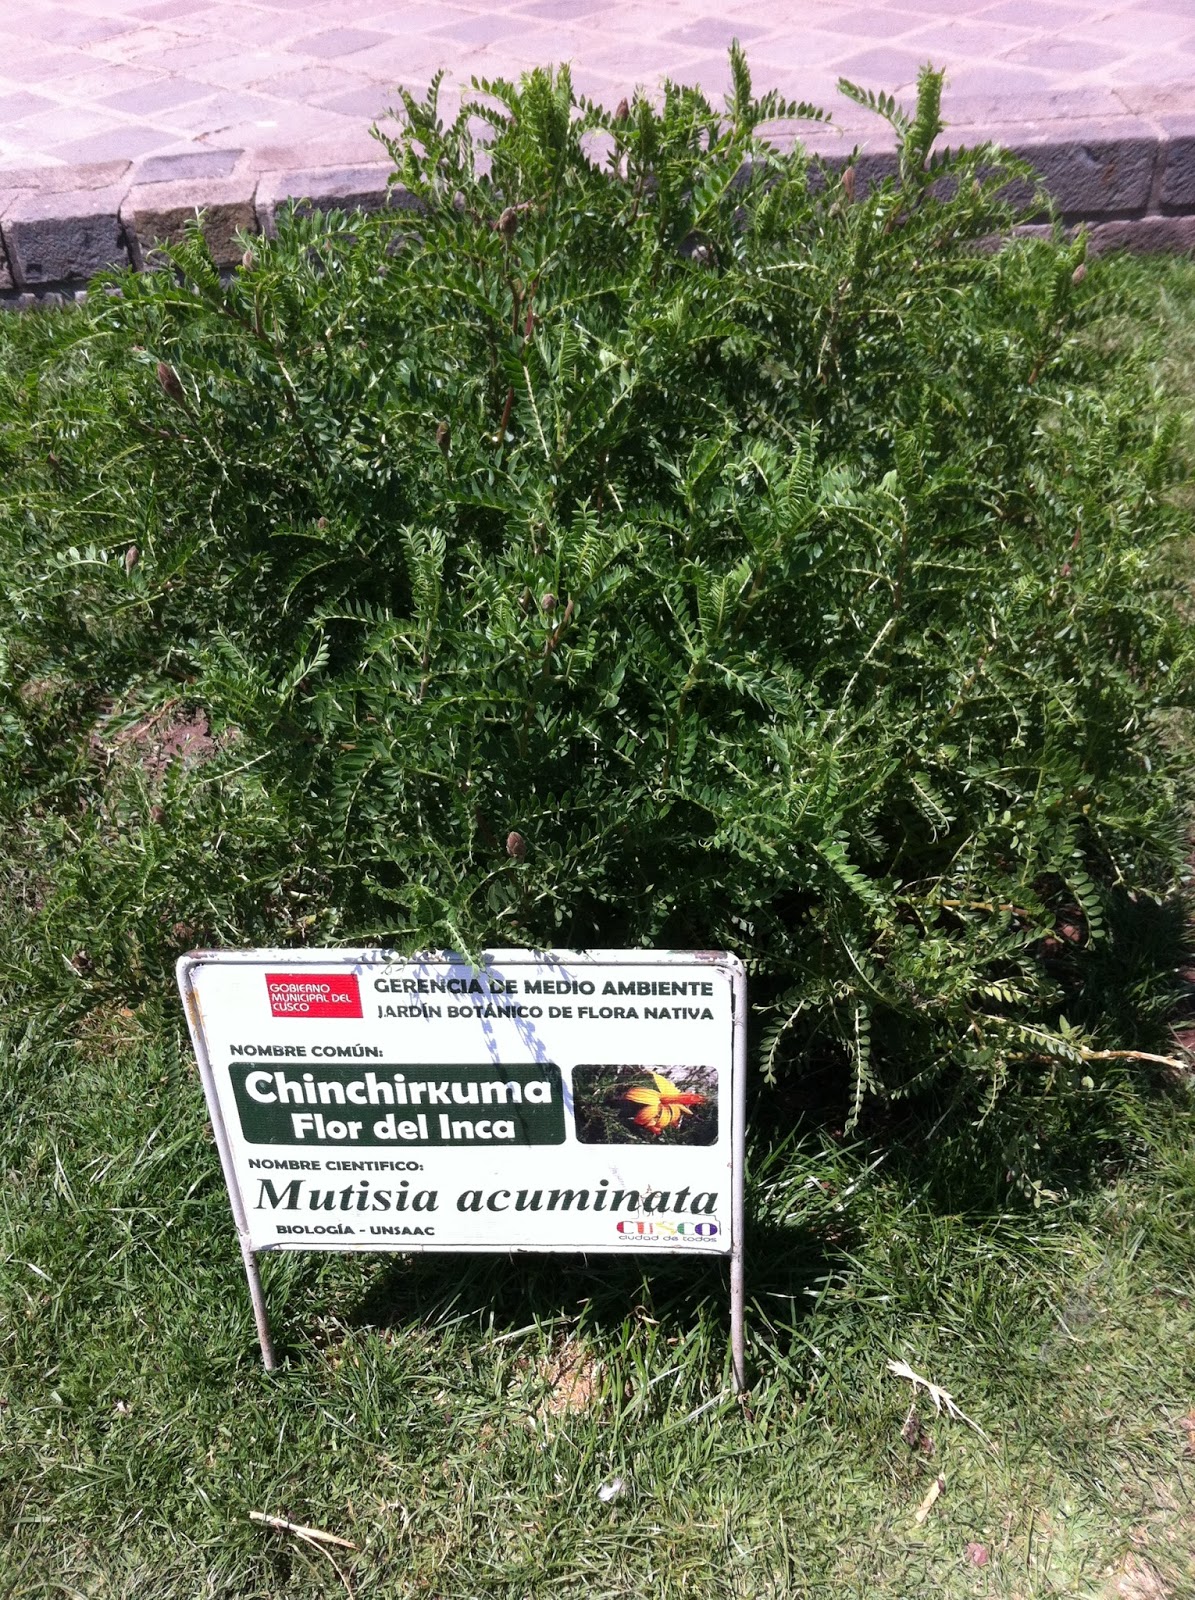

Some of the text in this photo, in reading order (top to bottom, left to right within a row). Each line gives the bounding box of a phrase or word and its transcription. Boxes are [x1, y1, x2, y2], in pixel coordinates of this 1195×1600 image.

[269, 983, 331, 994] GOBIERNO
[374, 978, 714, 996] GERENCIA DE MEDIO AMBIENTE
[271, 993, 352, 1003] MUNICIPAL DEL
[273, 1002, 310, 1012] CUSCO
[378, 1002, 714, 1020] JARDÍN BOTÁNICO DE FLORA NATIVA
[229, 1043, 384, 1058] NOMBRE COMÚN:
[244, 1071, 553, 1105] Chinchirkuma
[290, 1112, 515, 1139] Flor del Inca
[248, 1158, 424, 1171] NOMBRE CIENTIFICO:
[253, 1178, 719, 1214] Mutisia acuminata
[276, 1223, 355, 1235] BIOLOGÍA
[369, 1226, 435, 1236] UNSAAC
[682, 1235, 718, 1243] todos
